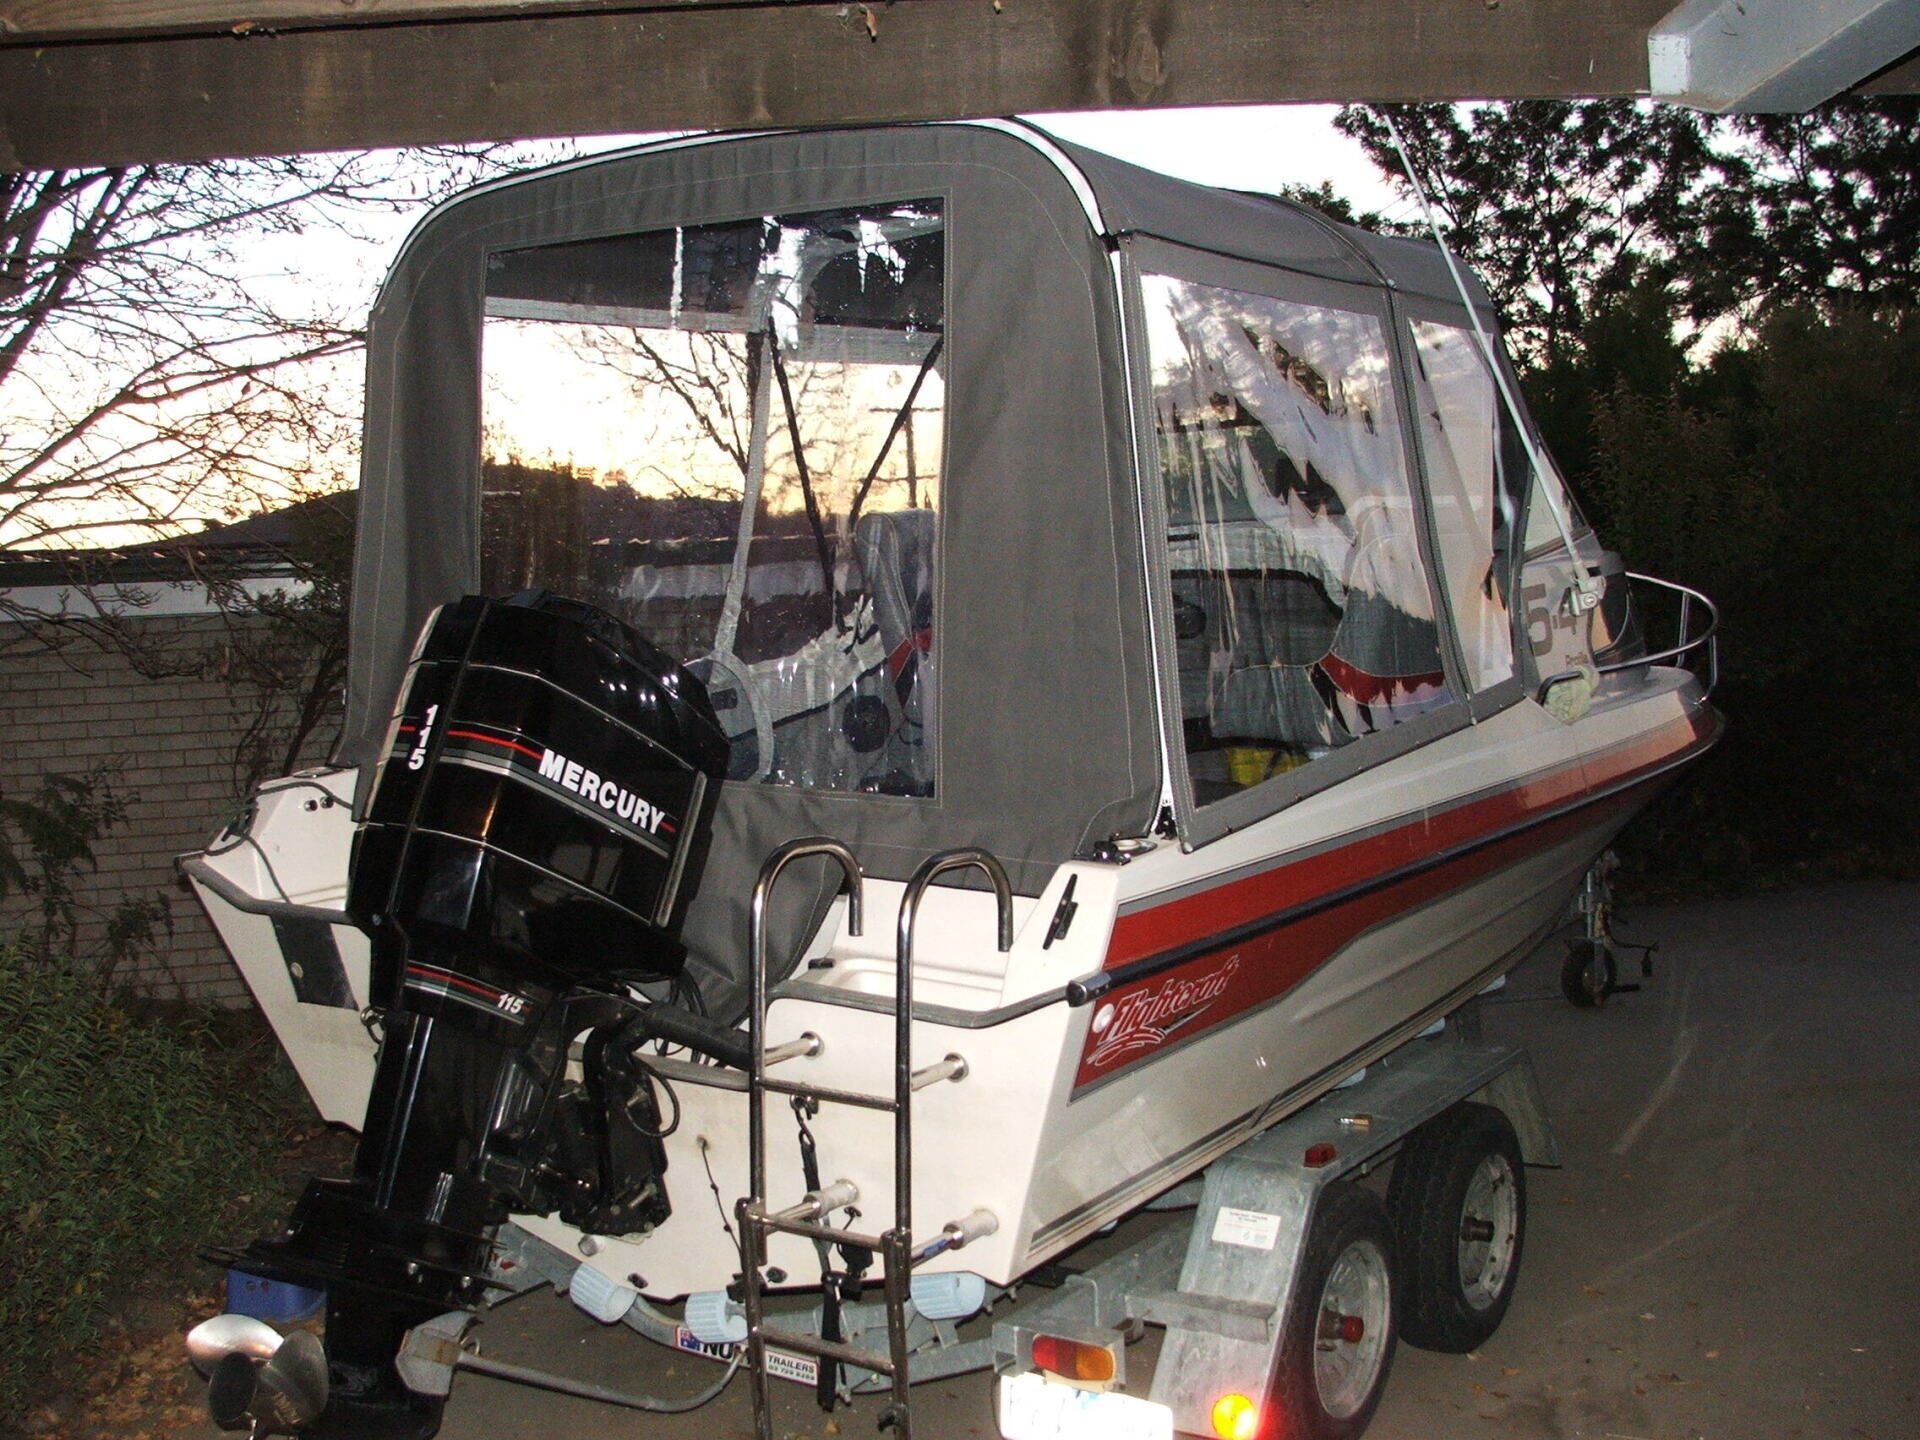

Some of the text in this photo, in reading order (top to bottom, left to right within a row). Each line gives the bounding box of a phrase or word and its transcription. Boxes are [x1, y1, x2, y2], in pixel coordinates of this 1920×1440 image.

[539, 748, 666, 835] MERCURY
[497, 993, 525, 1014] 115
[768, 1354, 816, 1374] TRAILERS
